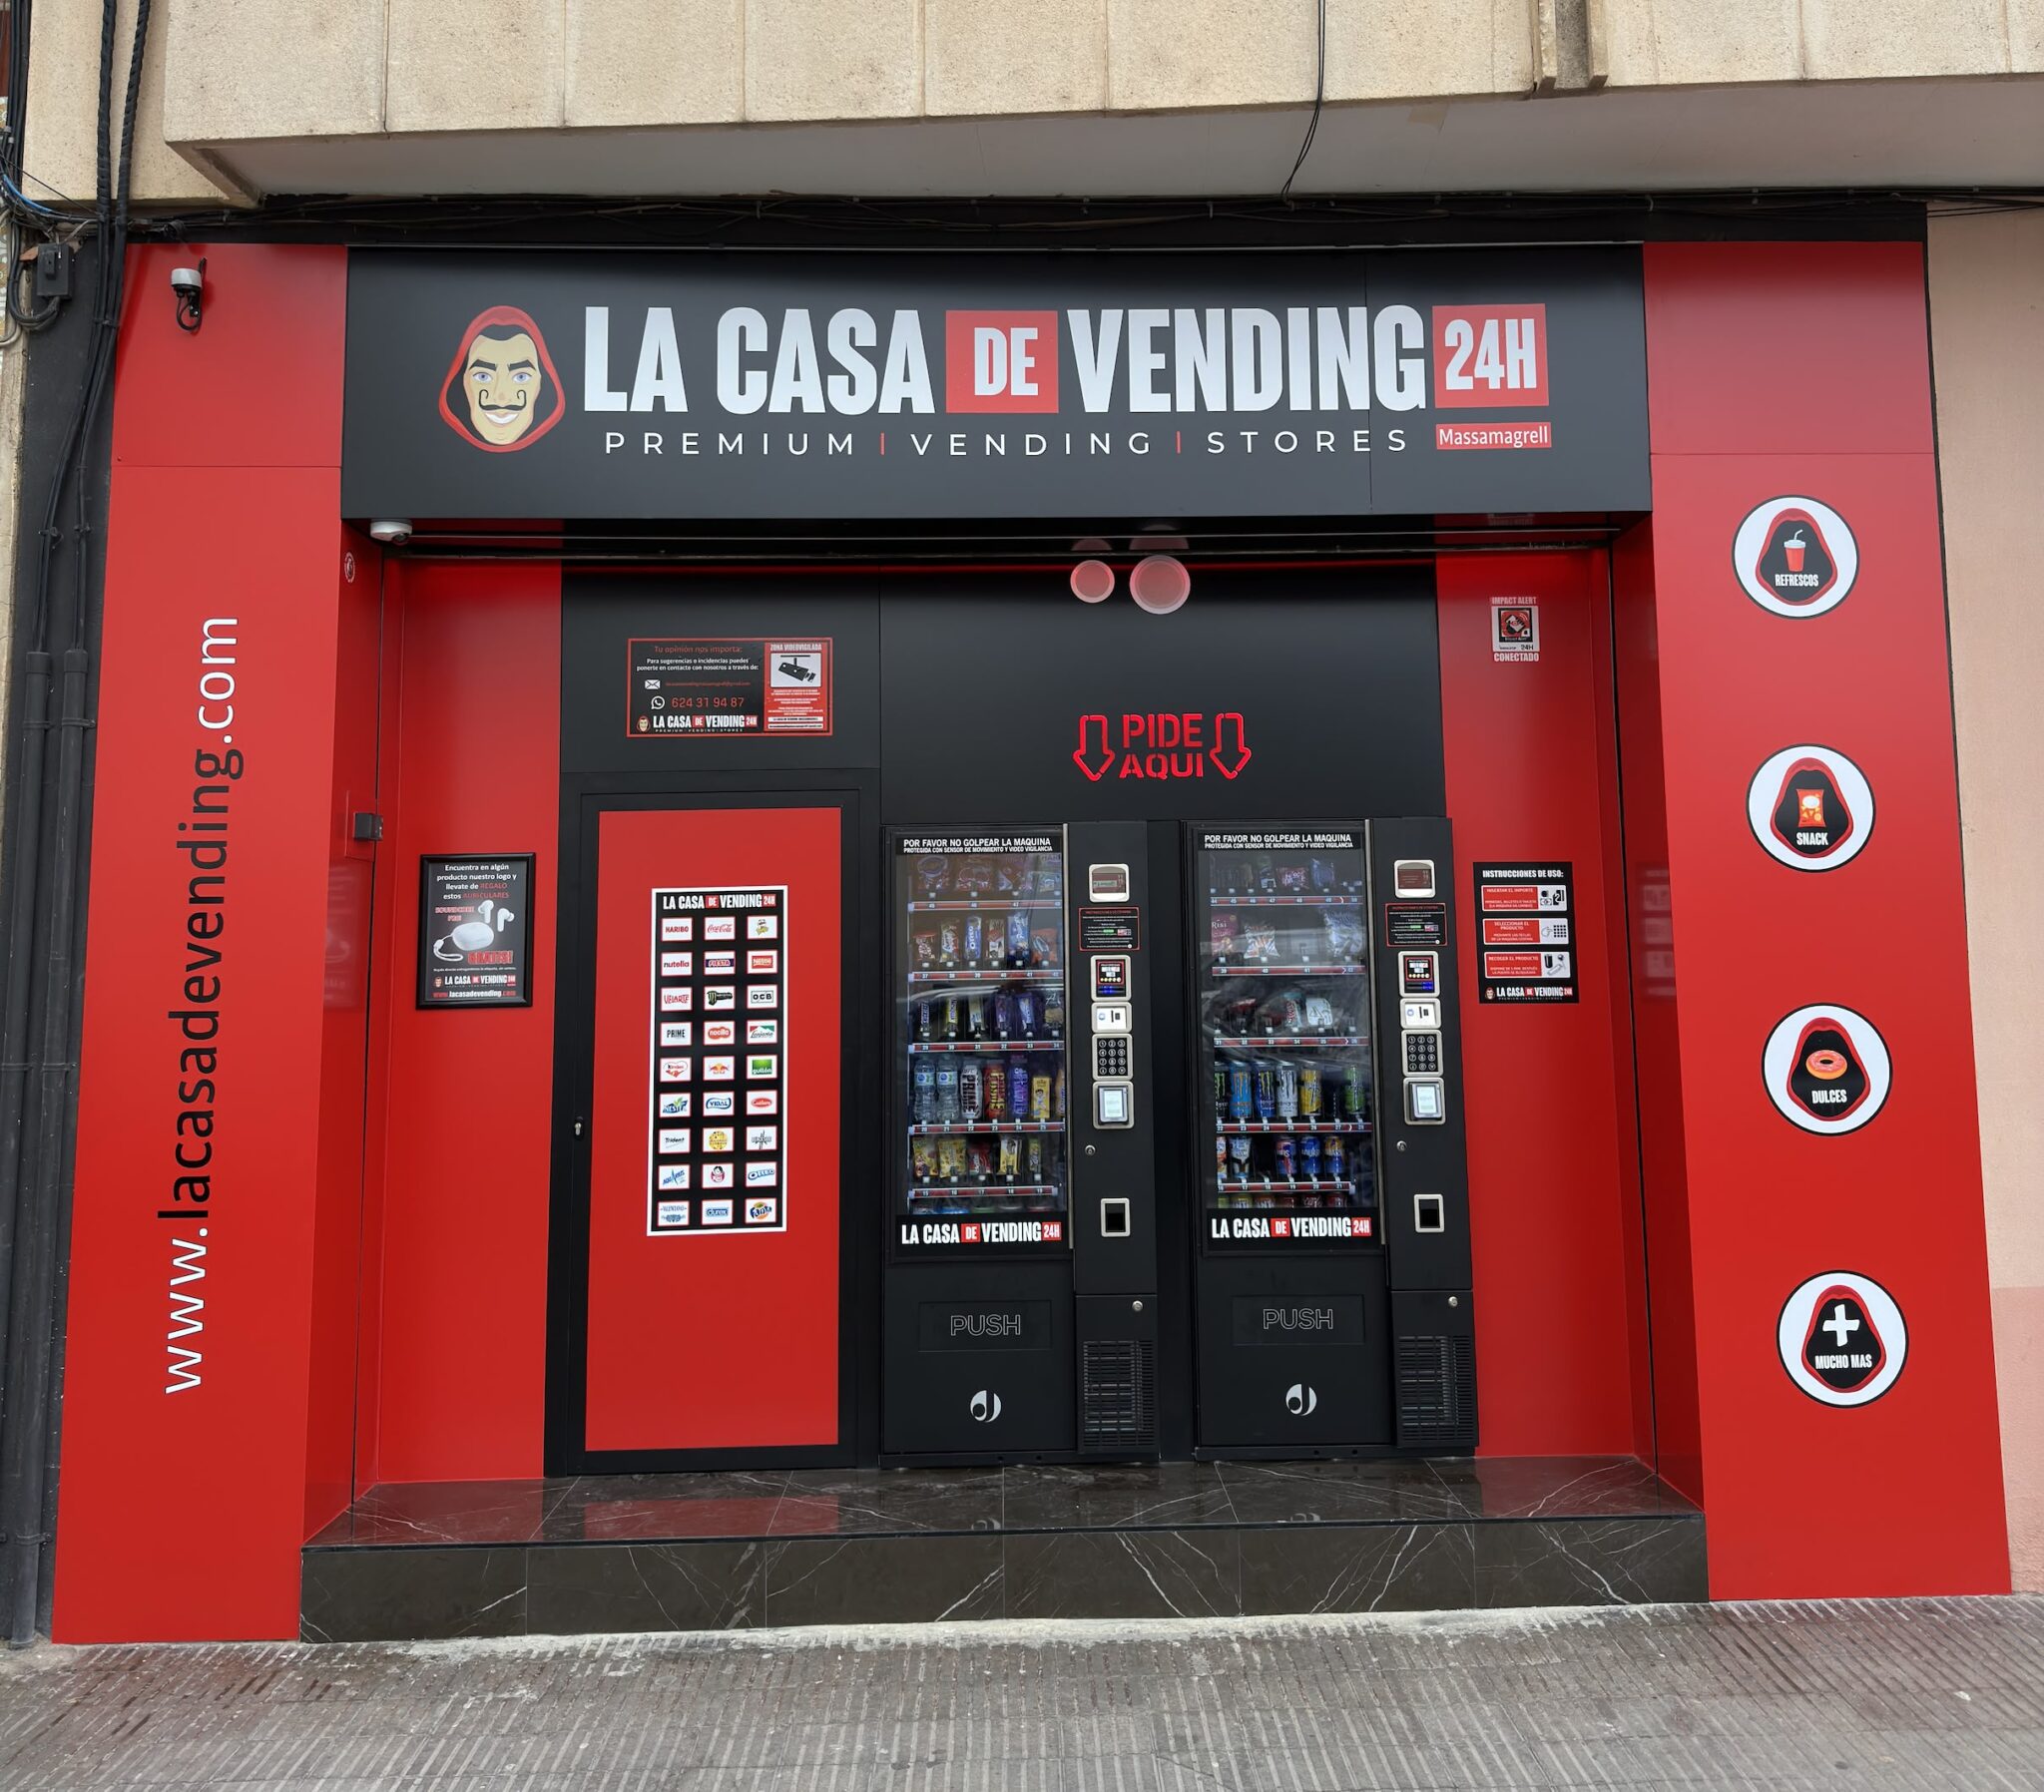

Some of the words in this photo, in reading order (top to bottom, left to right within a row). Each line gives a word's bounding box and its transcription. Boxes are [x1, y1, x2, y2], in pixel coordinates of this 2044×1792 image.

[584, 306, 689, 412] LA
[717, 307, 935, 415] CASA
[974, 327, 1038, 396] DE
[1067, 305, 1426, 412] VENDING
[1444, 318, 1537, 391] 24H
[606, 432, 853, 456] PREMIUM
[912, 432, 1150, 456] VENDING
[1208, 429, 1406, 453] STORES
[1439, 426, 1549, 449] Massamagrell
[1775, 574, 1818, 587] REFRESCOS
[1494, 653, 1539, 662] CONECTADO
[672, 697, 693, 707] 624
[696, 697, 709, 707] 31
[714, 697, 728, 706] 94
[731, 697, 744, 706] 87
[653, 715, 665, 728] LA
[667, 715, 692, 728] CASA
[695, 717, 704, 726] DE
[706, 715, 745, 727] VENDING
[746, 716, 757, 725] 24H
[1123, 713, 1203, 747] PIDE
[1119, 752, 1203, 779] AQUI
[1796, 832, 1828, 846] SNACK
[663, 896, 676, 909] LA
[679, 895, 705, 909] CASA
[709, 897, 717, 906] DE
[720, 894, 762, 908] VENDING
[764, 896, 775, 905] 24H
[480, 975, 507, 984] VENDING
[1496, 987, 1505, 997] LA
[1507, 987, 1525, 997] CASA
[1534, 987, 1563, 997] VENDING
[158, 617, 244, 1395] www.lacasadevending.com
[1811, 1090, 1847, 1104] DULCES
[750, 1206, 772, 1218] Fanta
[901, 1224, 919, 1244] LA
[923, 1223, 960, 1244] CASA
[965, 1226, 977, 1239] DE
[981, 1222, 1042, 1242] VENDING
[1044, 1224, 1060, 1238] 24H
[1212, 1218, 1230, 1238] LA
[1233, 1218, 1271, 1237] CASA
[1276, 1221, 1287, 1234] DE
[1290, 1217, 1351, 1237] VENDING
[1353, 1220, 1369, 1233] 24H
[950, 1314, 1021, 1336] PUSH
[1263, 1308, 1333, 1330] PUSH
[1815, 1355, 1848, 1369] MUCHO
[1851, 1354, 1872, 1368] MAS
